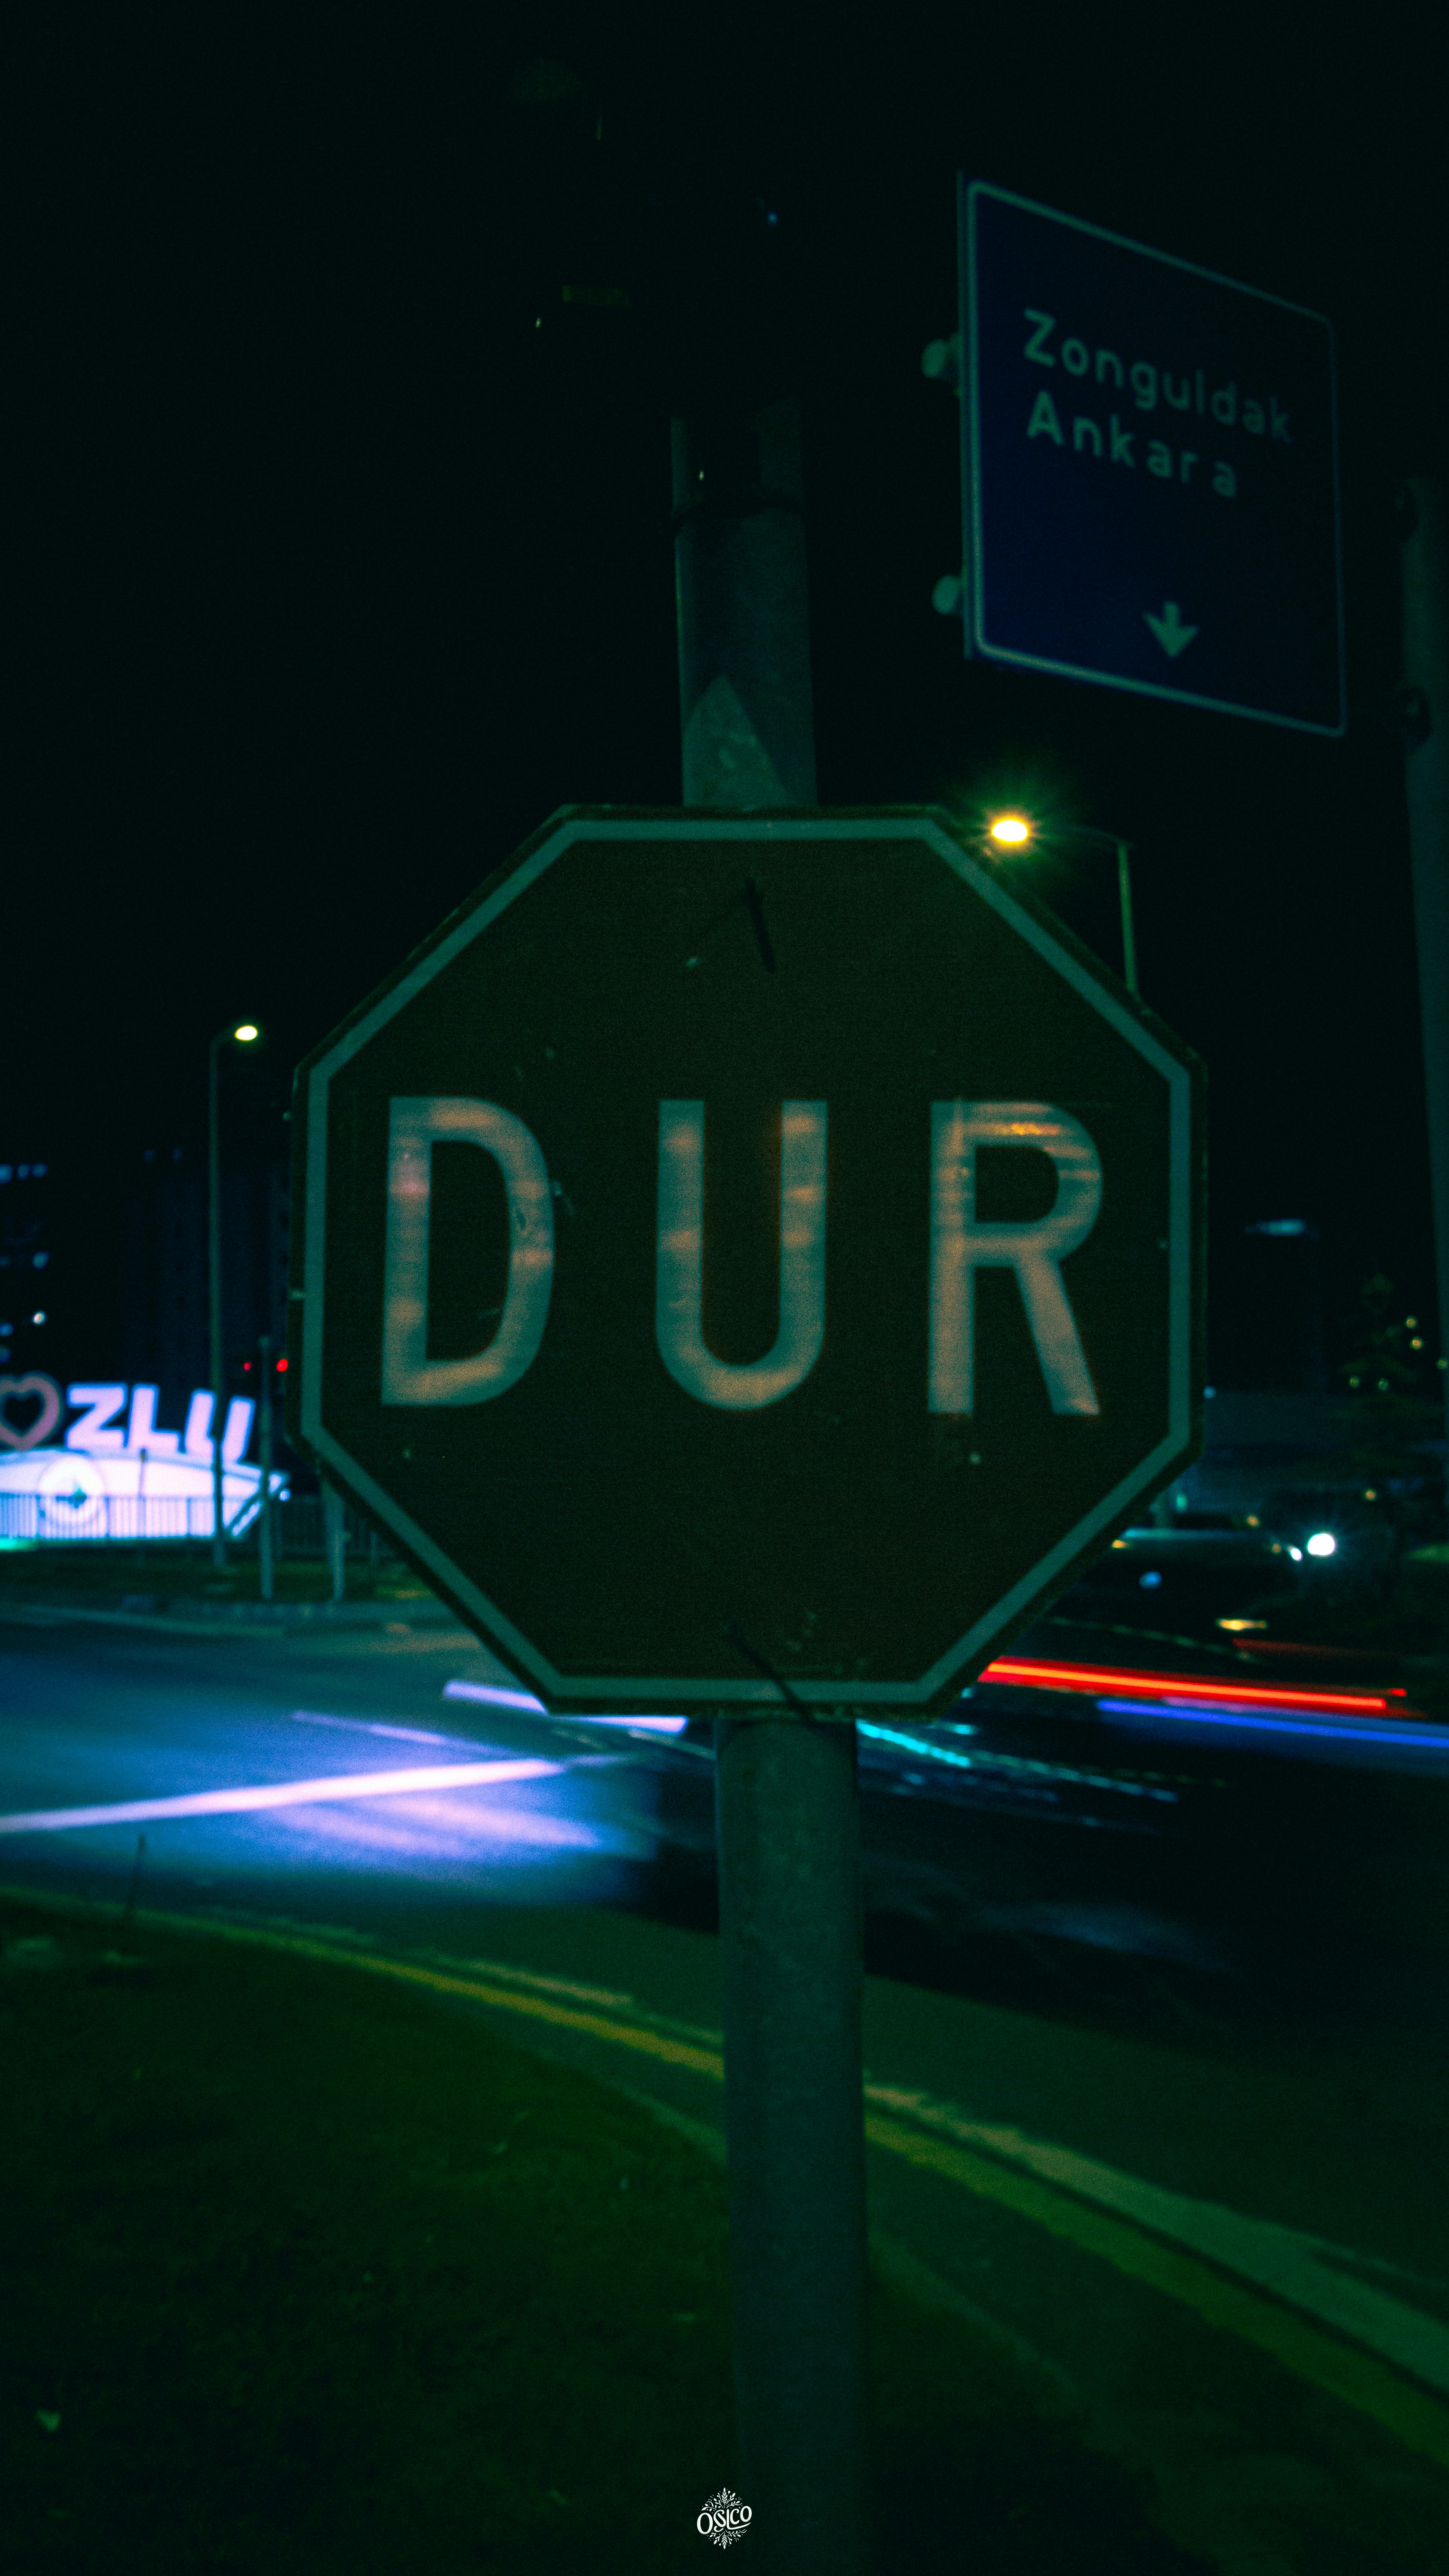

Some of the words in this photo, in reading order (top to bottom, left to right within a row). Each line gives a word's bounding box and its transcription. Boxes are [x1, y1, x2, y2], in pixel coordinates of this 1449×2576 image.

[1023, 307, 1293, 444] Zonguldak
[1025, 390, 1237, 498] Ankara
[381, 1096, 1103, 1416] DUR
